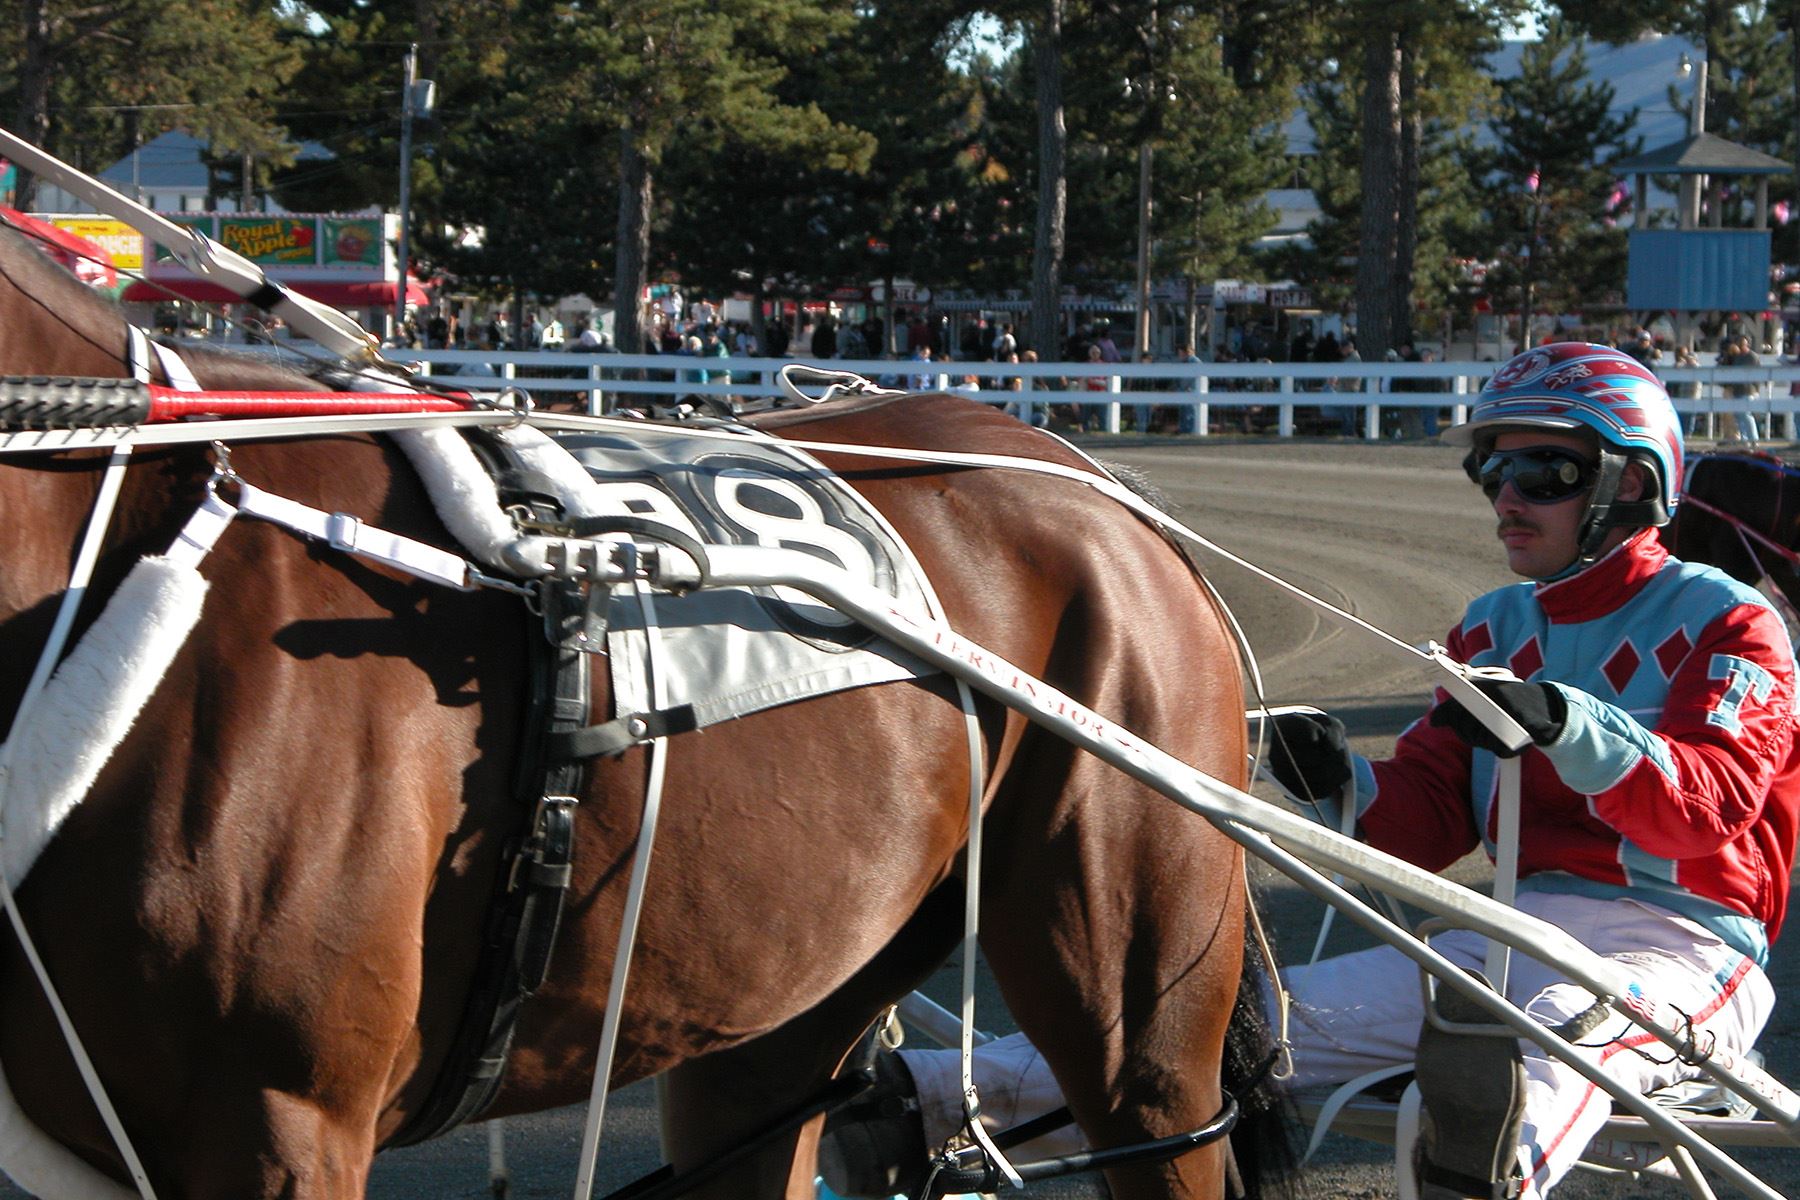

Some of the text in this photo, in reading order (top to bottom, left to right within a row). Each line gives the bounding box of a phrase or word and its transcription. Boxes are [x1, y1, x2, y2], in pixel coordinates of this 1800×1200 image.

[84, 232, 144, 256] OUGH
[223, 220, 283, 245] Royal
[239, 233, 297, 257] Apple
[1706, 653, 1775, 740] T
